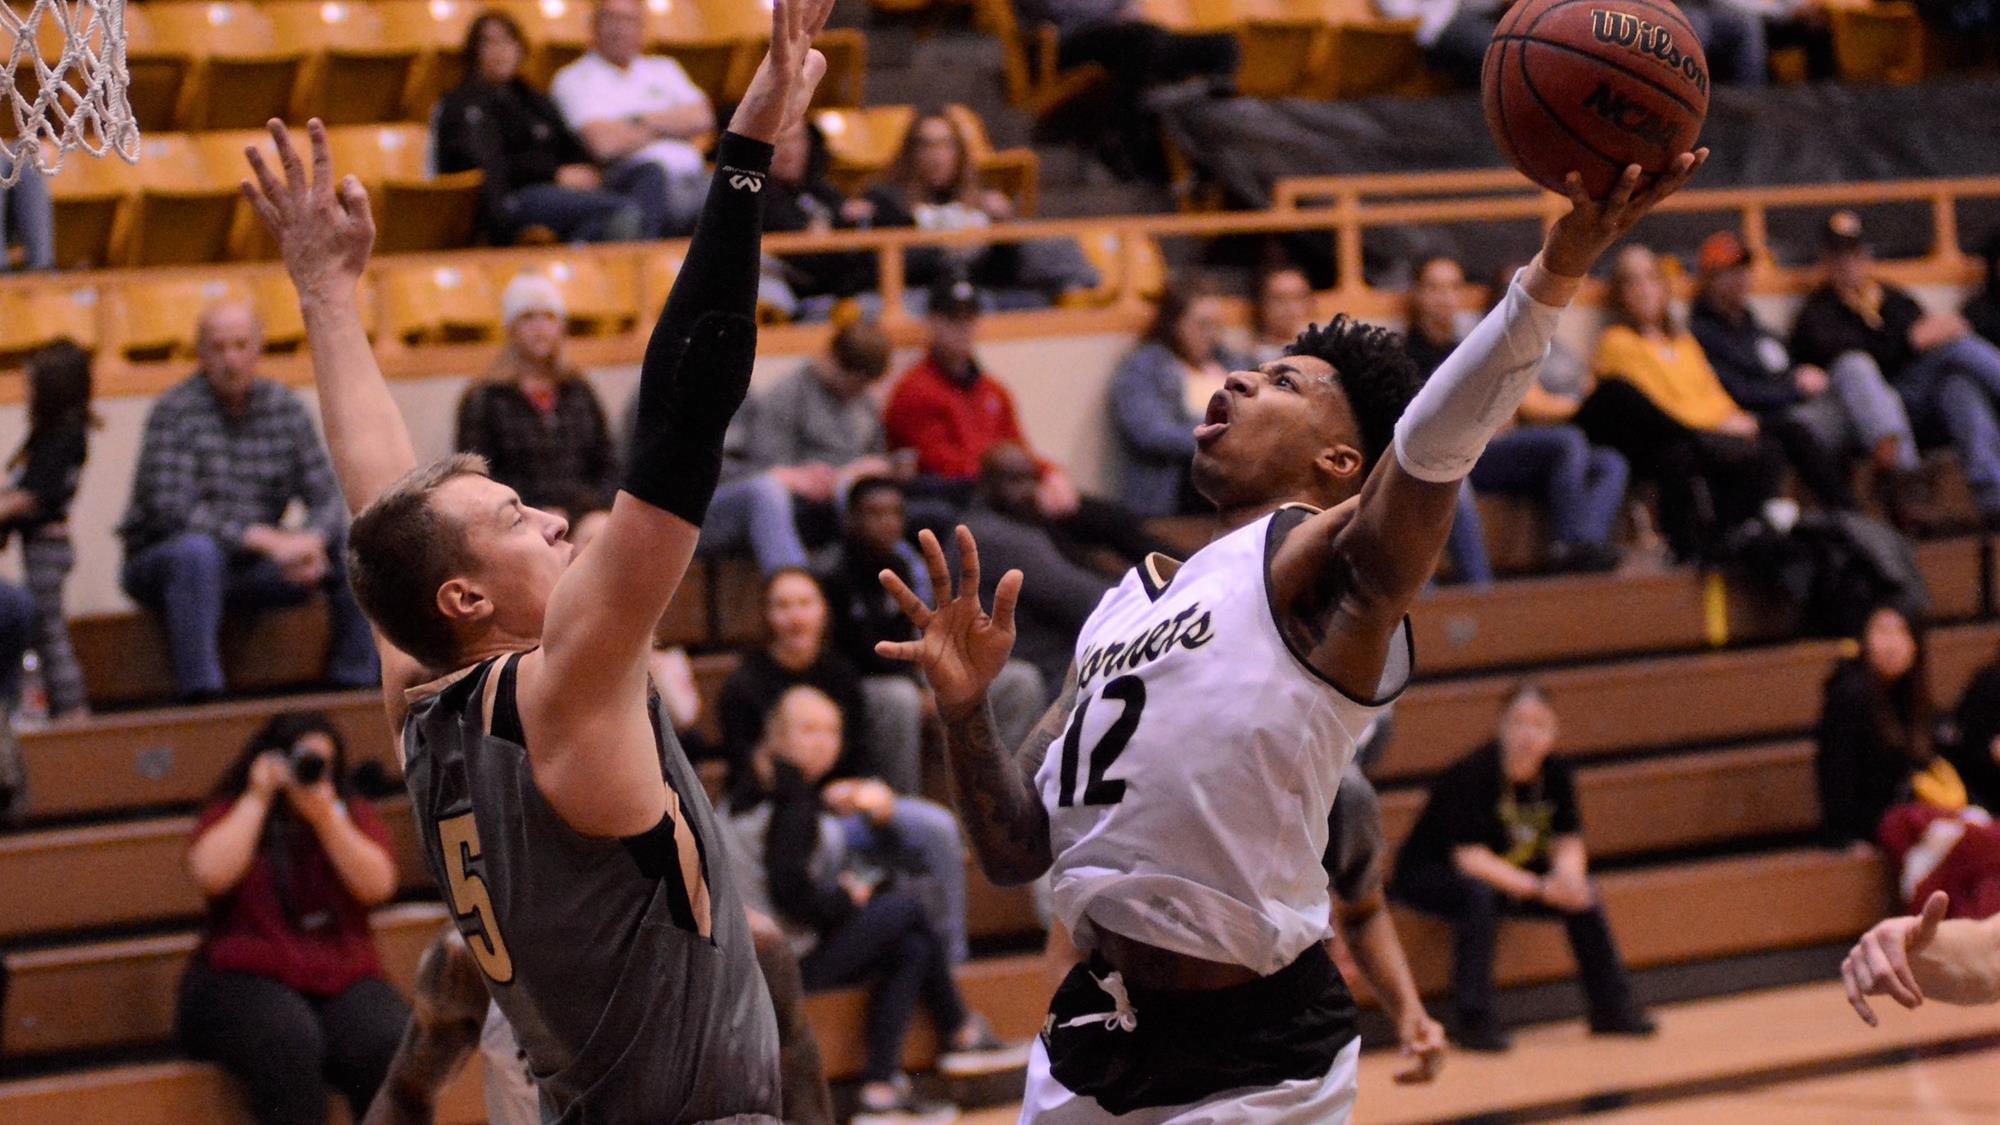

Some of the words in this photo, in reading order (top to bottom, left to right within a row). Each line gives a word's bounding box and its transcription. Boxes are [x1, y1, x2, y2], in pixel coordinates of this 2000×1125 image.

[1591, 8, 1708, 96] Wilson
[1077, 601, 1214, 689] ornets
[1058, 674, 1147, 808] 12
[436, 808, 515, 985] 5
